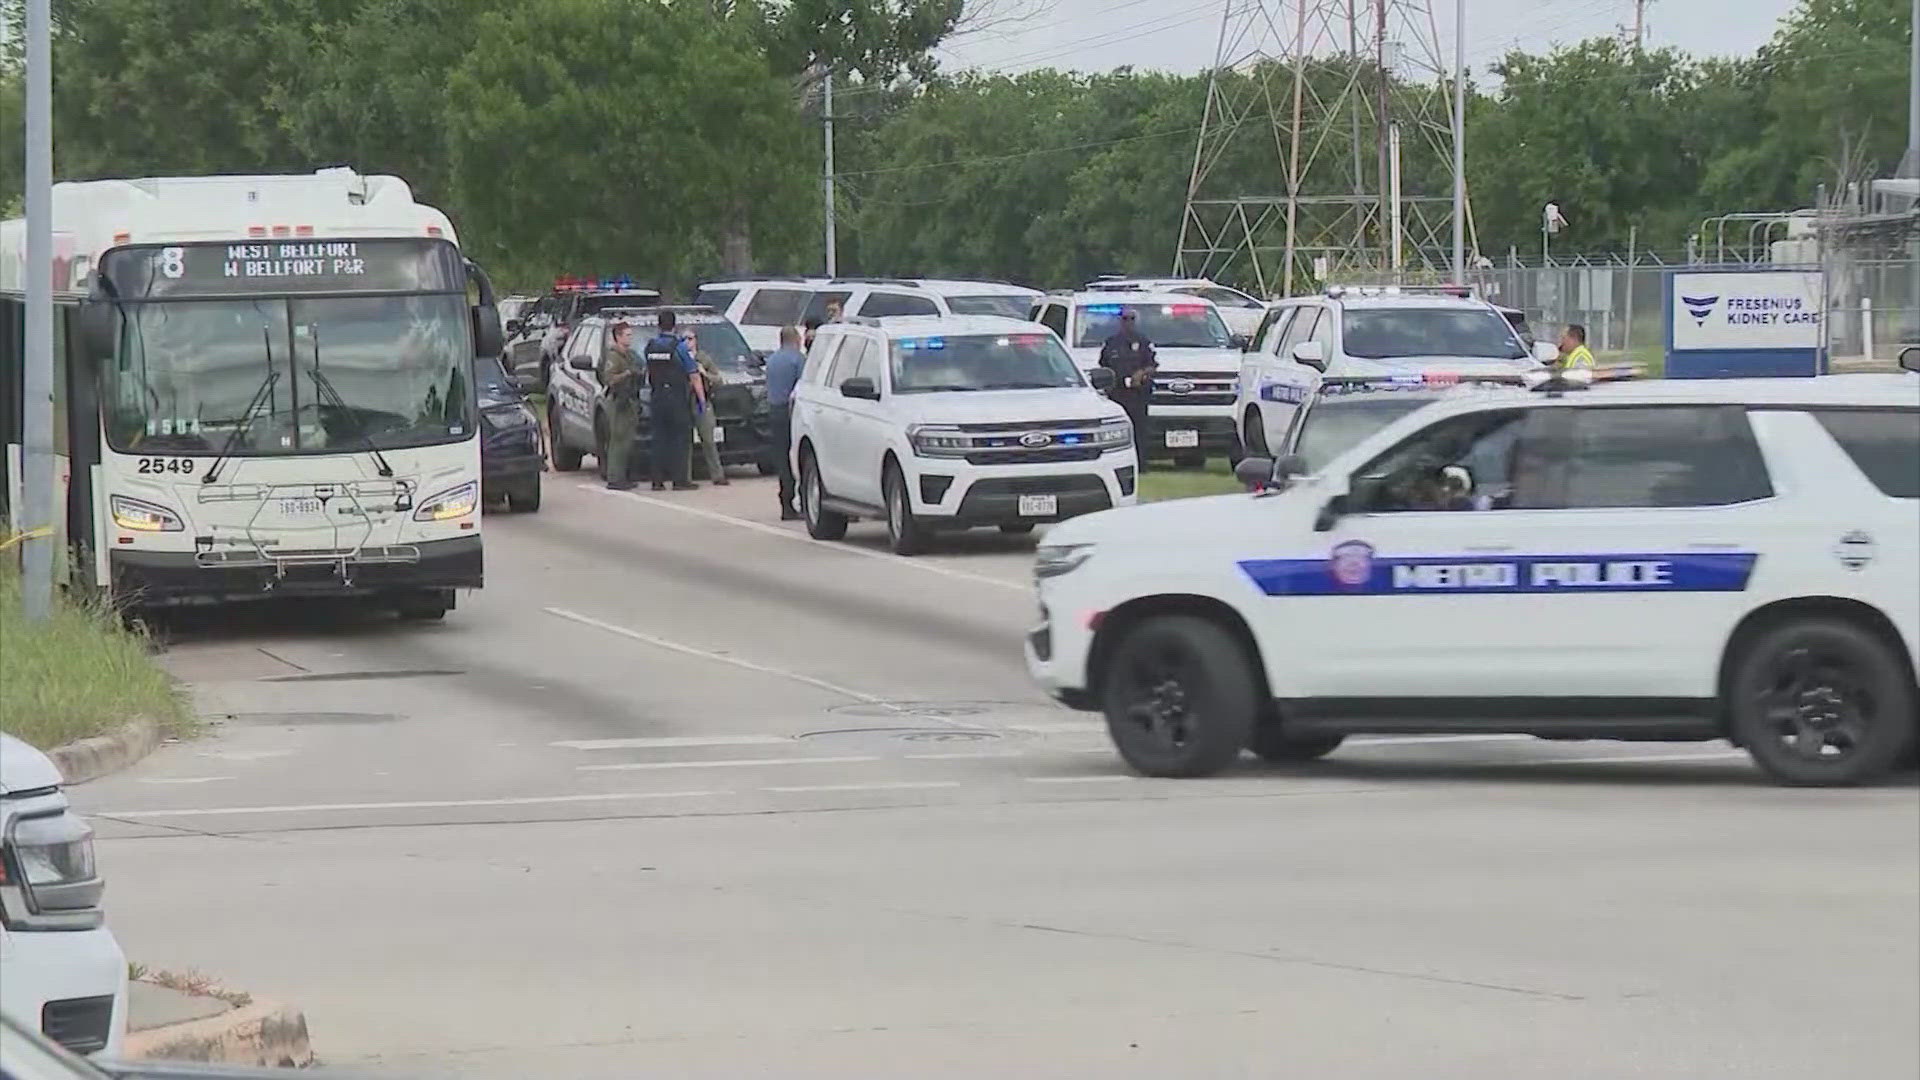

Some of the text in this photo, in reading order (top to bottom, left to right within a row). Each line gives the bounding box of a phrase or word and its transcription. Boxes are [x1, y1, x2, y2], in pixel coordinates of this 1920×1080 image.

[228, 245, 270, 260] WEST
[162, 247, 185, 279] 8
[224, 259, 365, 277] W BELLFORT P&R
[1727, 298, 1803, 311] FRESENIUS
[1727, 313, 1820, 325] KIDNEY CARE
[138, 458, 194, 474] 2549
[1391, 564, 1518, 588] METRO
[1530, 561, 1674, 586] POLICE
